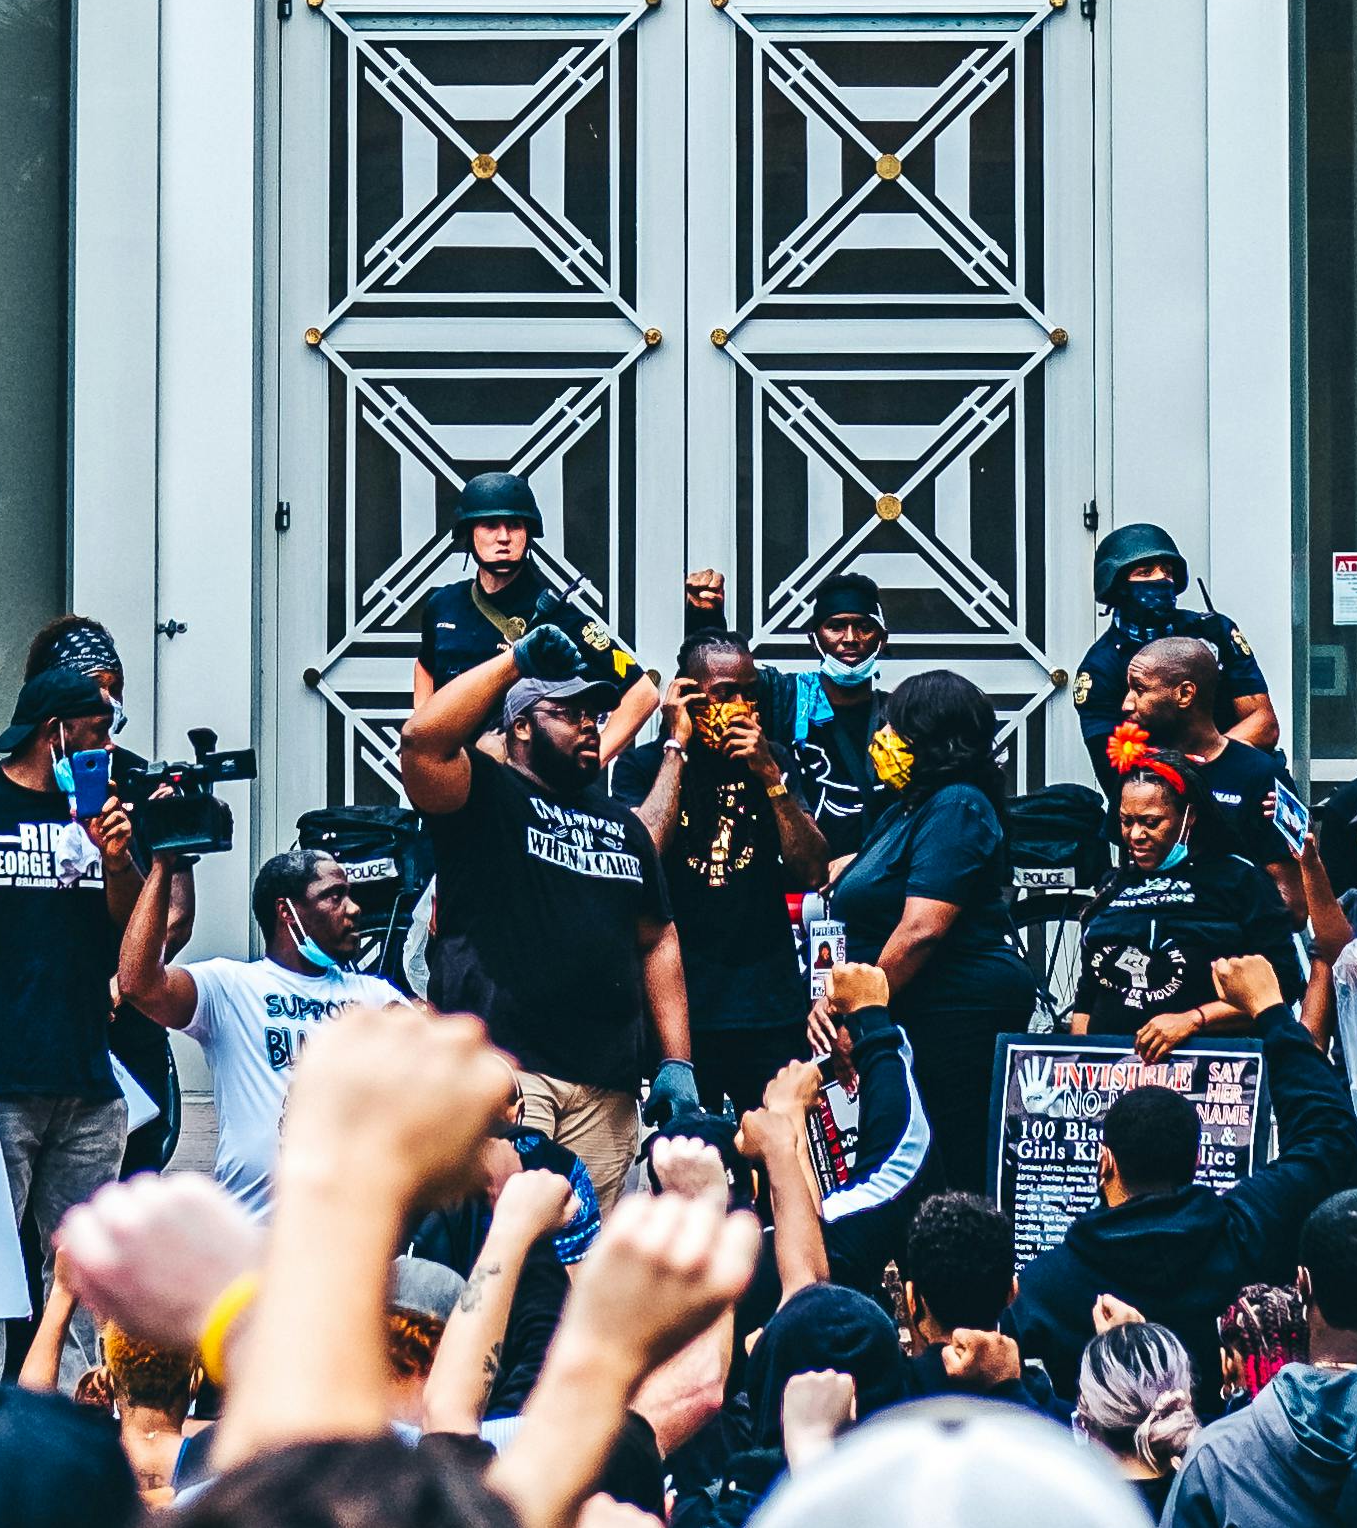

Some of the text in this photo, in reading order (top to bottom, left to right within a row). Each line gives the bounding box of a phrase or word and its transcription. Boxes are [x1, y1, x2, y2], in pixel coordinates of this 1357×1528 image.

[345, 862, 388, 880] POLICE
[1023, 872, 1066, 884] POLICE
[1146, 976, 1183, 1002] VIOLENT
[1208, 1060, 1247, 1084] SAY
[1062, 1091, 1103, 1118] NO
[1205, 1083, 1244, 1105] HER
[1196, 1104, 1251, 1126] NAME
[1020, 1120, 1104, 1141] 100 Bla
[1220, 1127, 1237, 1146] &
[1017, 1141, 1067, 1161] Girls
